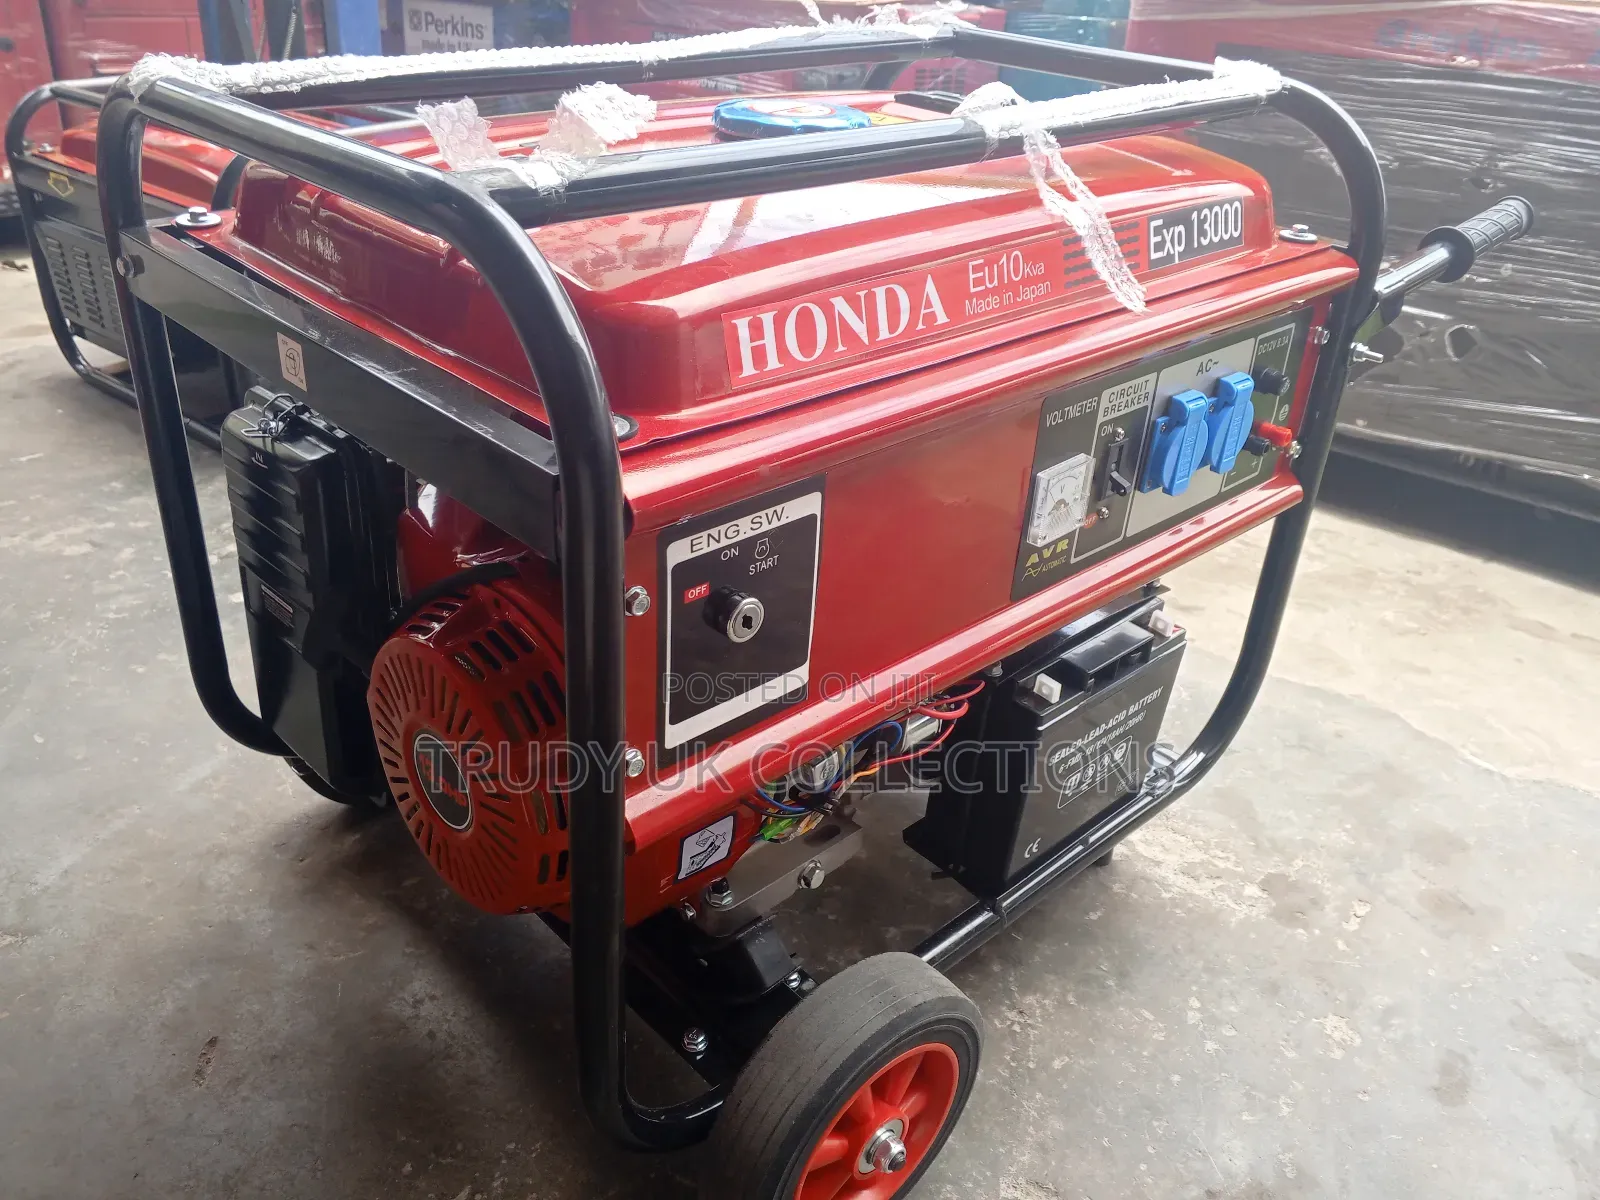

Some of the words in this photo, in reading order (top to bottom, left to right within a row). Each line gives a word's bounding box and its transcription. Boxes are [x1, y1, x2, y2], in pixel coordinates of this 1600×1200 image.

[424, 11, 485, 40] Perkins
[1149, 218, 1186, 264] Exp
[1191, 200, 1242, 249] 13000
[965, 293, 1000, 317] Made
[1003, 289, 1014, 306] in
[1016, 281, 1052, 303] Japan
[731, 273, 950, 379] HONDA
[1102, 391, 1150, 418] BREAKER
[1107, 380, 1150, 404] CIRCUIT
[1045, 396, 1099, 427] VOLTMETER
[1101, 424, 1115, 437] ON
[720, 545, 740, 562] ON
[748, 554, 779, 576] START
[1025, 538, 1069, 568] AVR
[688, 584, 708, 599] OFF
[1127, 686, 1164, 717] BATTERY
